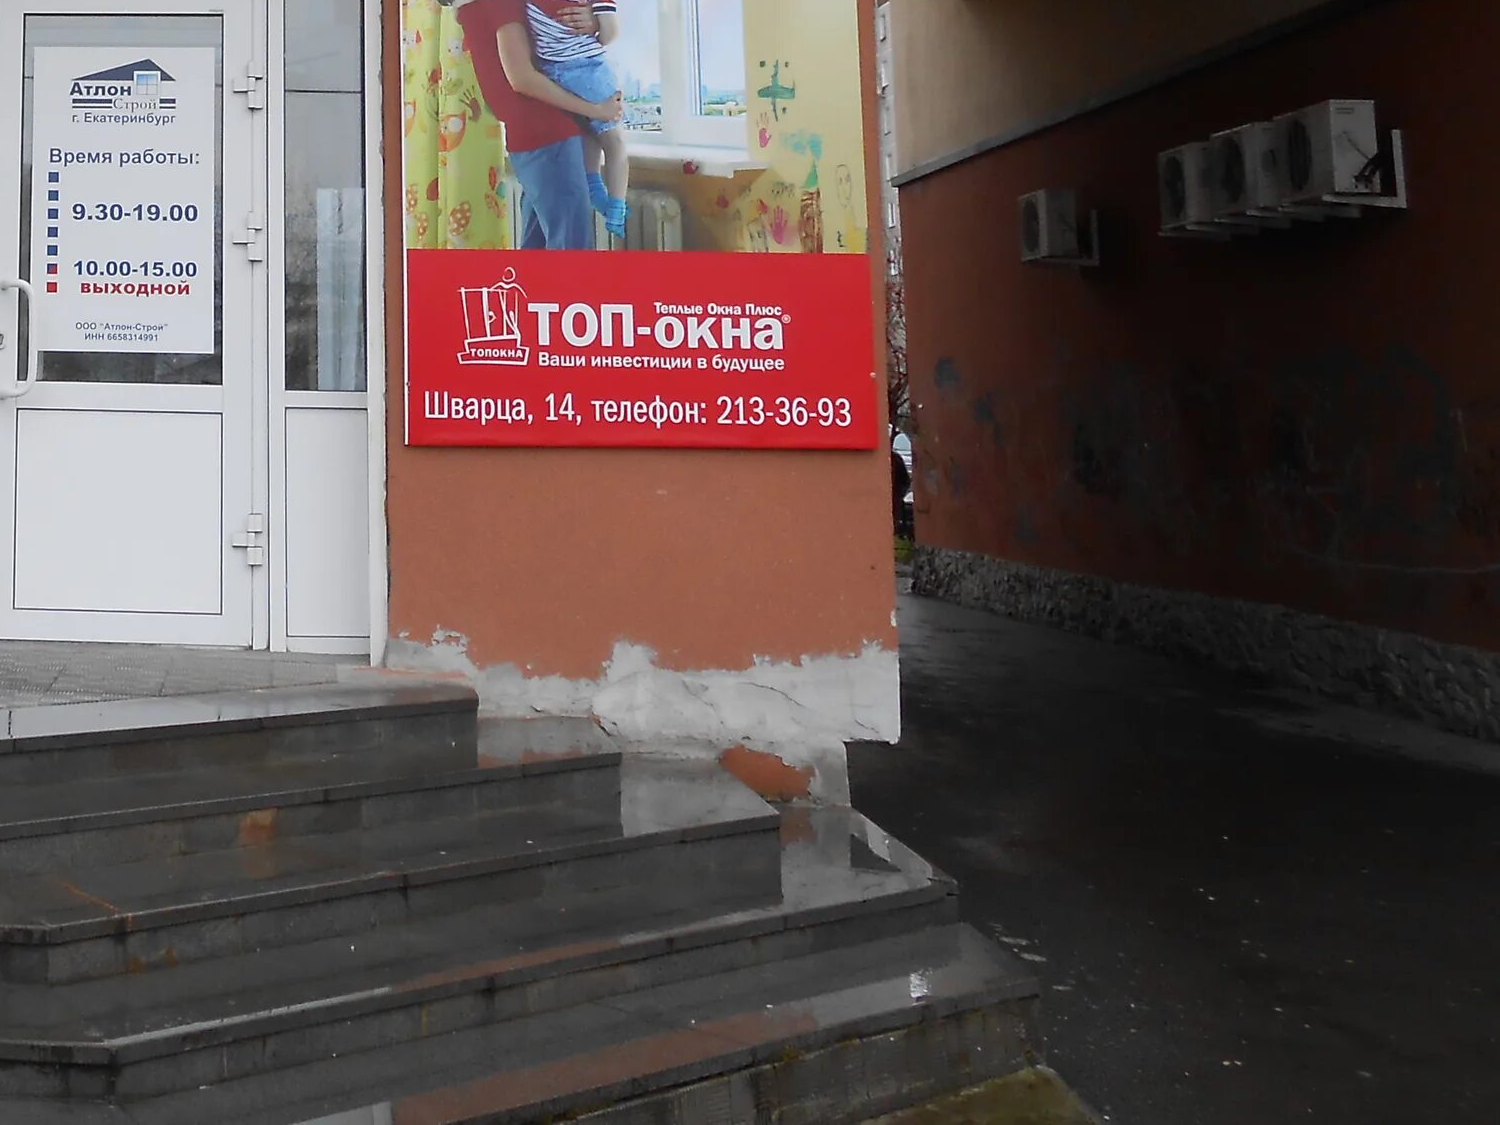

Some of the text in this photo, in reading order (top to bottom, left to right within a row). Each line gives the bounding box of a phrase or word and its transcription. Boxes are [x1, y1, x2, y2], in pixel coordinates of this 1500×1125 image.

[69, 82, 132, 97] Атлон
[113, 98, 158, 113] Строй
[72, 113, 176, 125] г. Екатеринбург
[49, 148, 200, 167] Время работы:
[71, 203, 199, 222] 9.30-19.00
[73, 260, 198, 277] 10.00-15.00
[80, 280, 191, 297] выходной
[653, 301, 783, 317] Теплые Окна Плюс
[75, 322, 98, 330] ООО
[84, 333, 105, 341] ИНН
[469, 347, 524, 359] ТОПОКНА
[538, 352, 786, 373] Ваши инвестиции в будущее
[423, 390, 853, 429] Шварца, 14, телефон: 213-36-93
